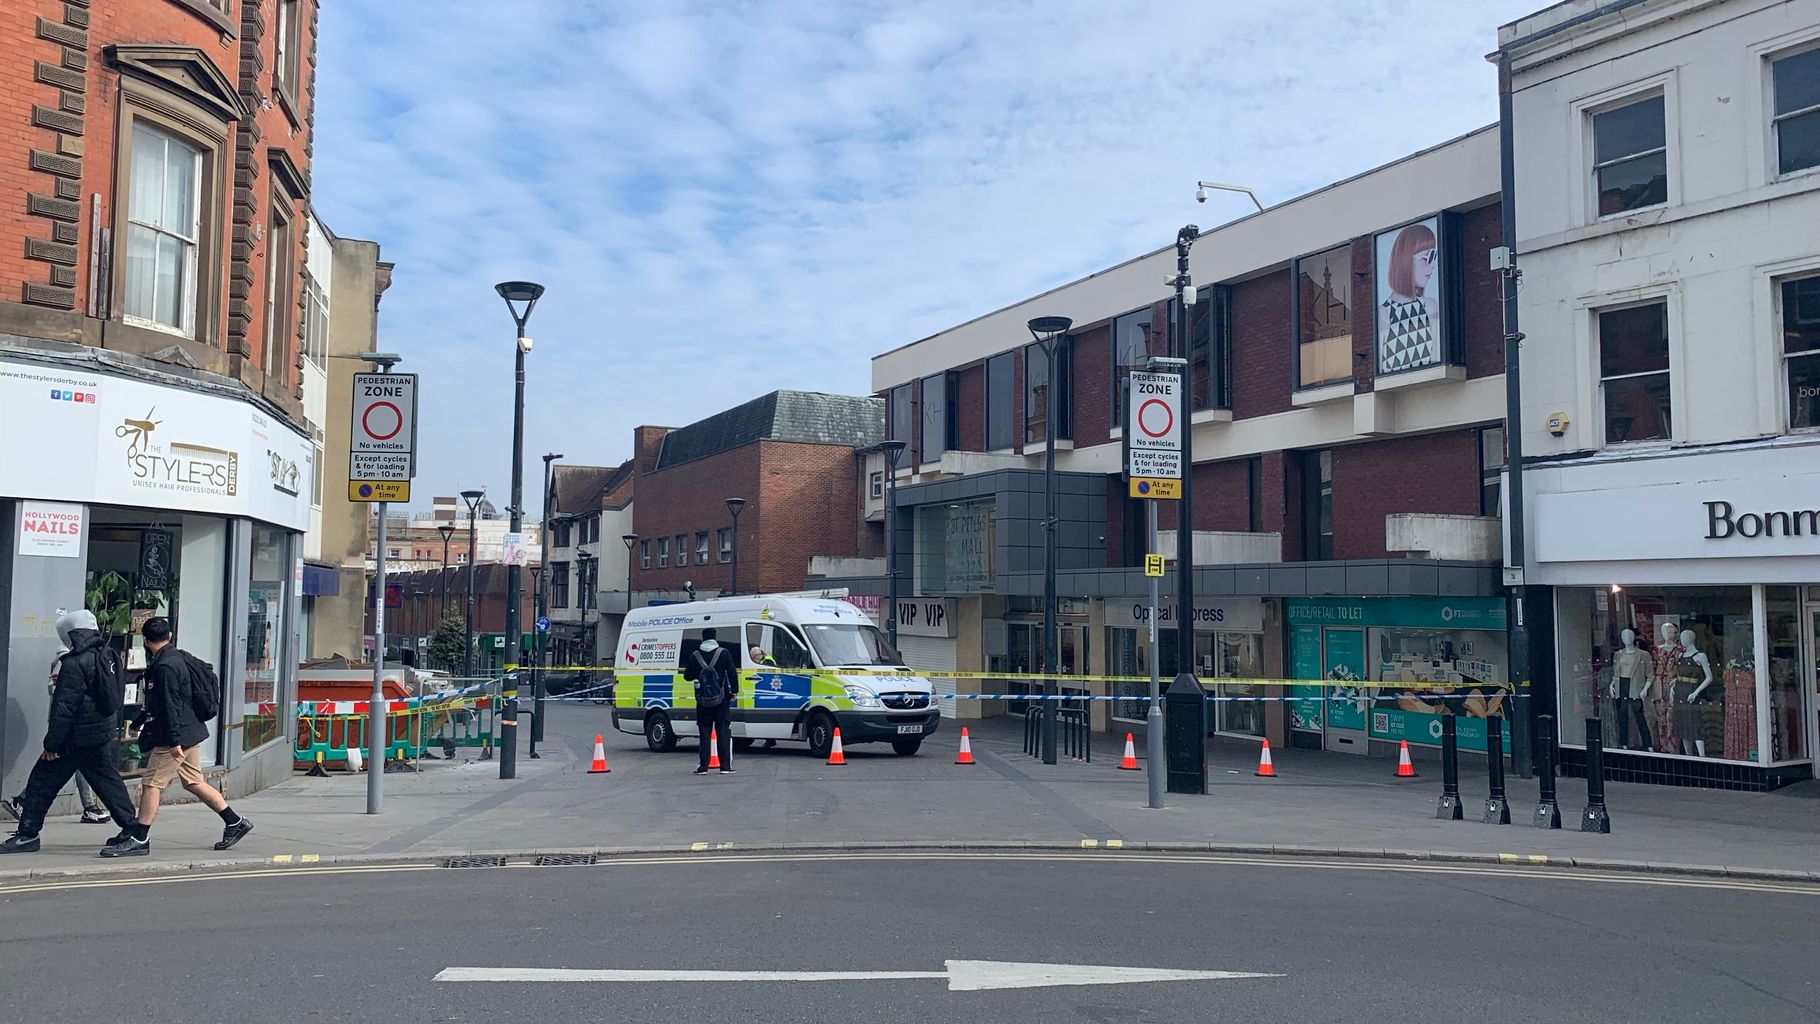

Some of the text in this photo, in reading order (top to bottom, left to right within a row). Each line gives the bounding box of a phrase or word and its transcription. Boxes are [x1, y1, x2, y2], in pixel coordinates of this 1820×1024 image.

[357, 377, 411, 385] PEDESTRIAN
[1132, 374, 1179, 383] PEDESTRIAN
[364, 386, 402, 397] ZONE
[1139, 383, 1172, 395] ZONE
[372, 442, 404, 450] vehicles
[1148, 439, 1175, 447] vehicles
[150, 445, 162, 454] THE
[354, 455, 408, 463] Except cycles
[1133, 452, 1179, 461] Except cycles
[134, 454, 227, 487] STYLERS
[377, 463, 405, 471] loading
[228, 455, 237, 493] DERBY
[132, 480, 226, 496] UNISEX HAIR PROFESSIONALS
[378, 491, 396, 499] time
[25, 511, 80, 521] HOLLYWOOD
[1702, 500, 1820, 539] Bonm
[24, 520, 79, 535] NAILS
[145, 533, 171, 546] OPEN
[898, 603, 945, 627] VIP VIP
[1133, 603, 1172, 624] Opcal
[1337, 606, 1348, 619] TO
[1349, 607, 1363, 620] LET
[628, 616, 694, 628] Mobile POLICE Office
[640, 651, 675, 660] 0800 555 111
